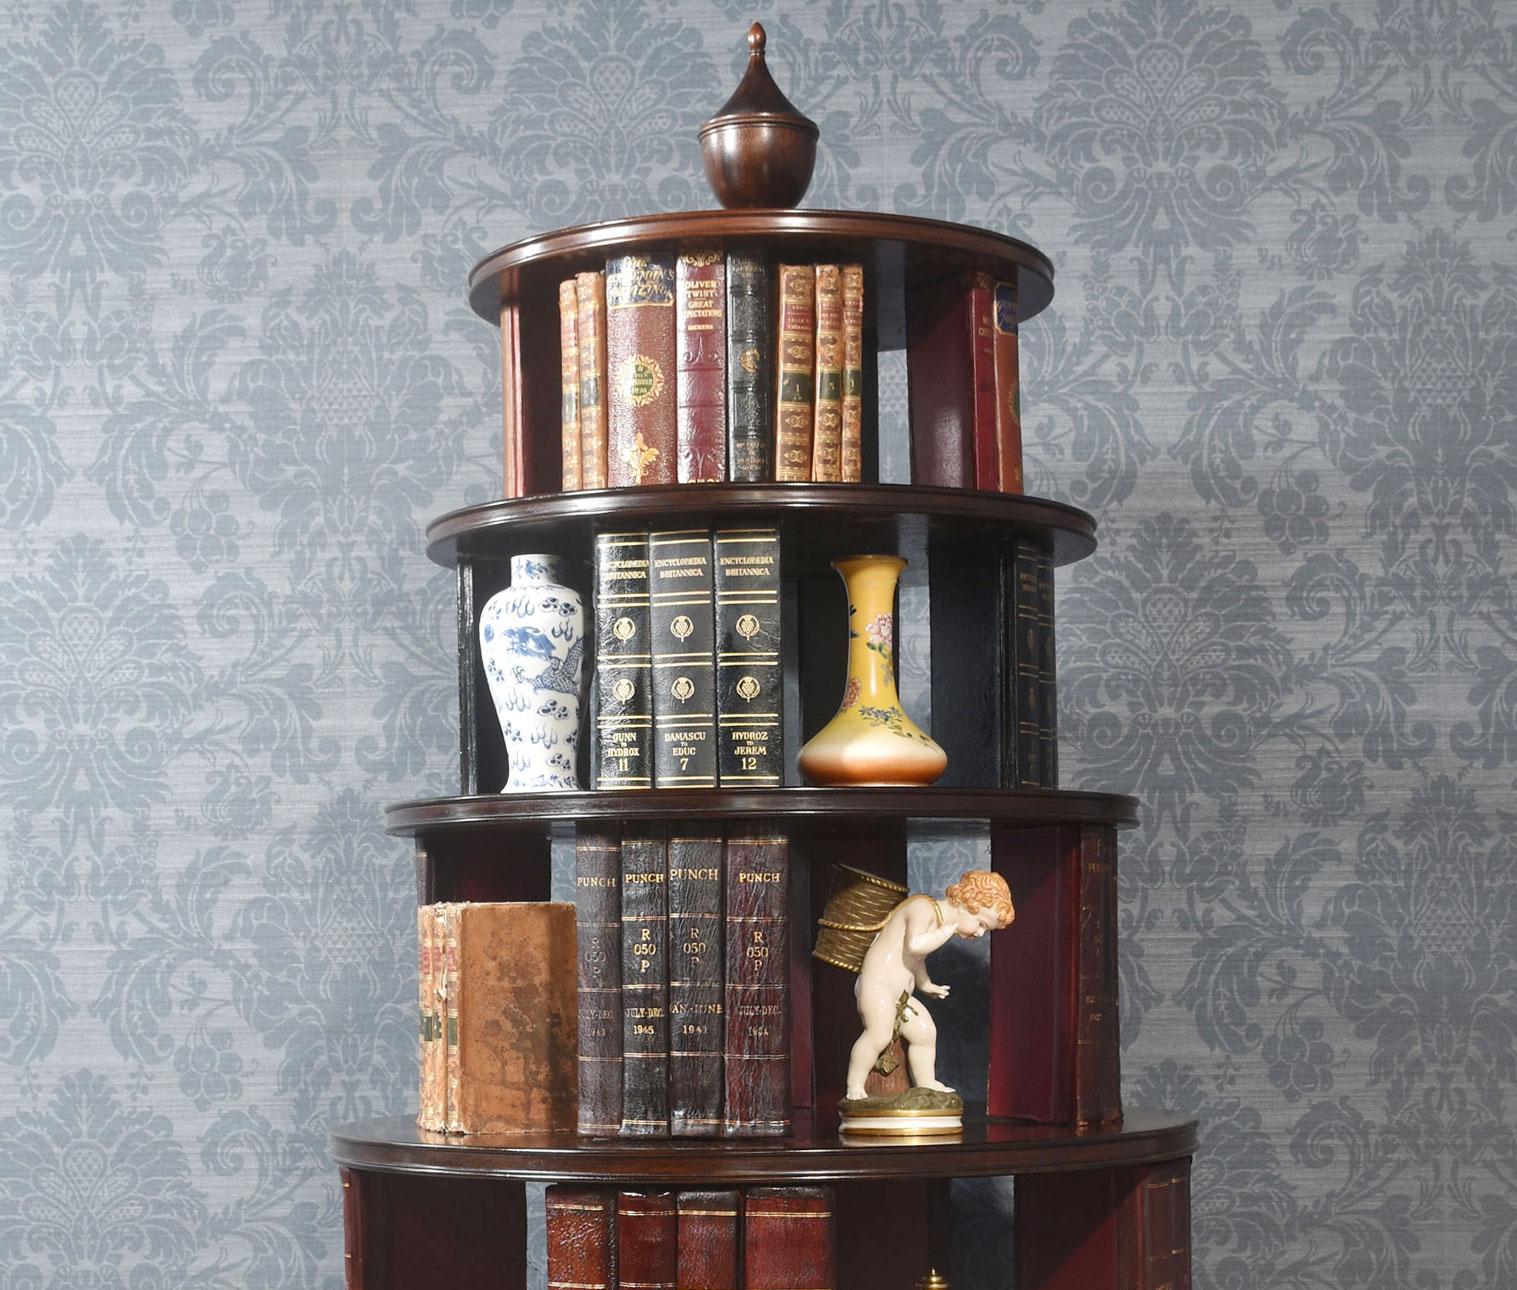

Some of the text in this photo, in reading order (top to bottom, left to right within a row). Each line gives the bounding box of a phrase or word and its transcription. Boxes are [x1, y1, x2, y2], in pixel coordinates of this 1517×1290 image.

[685, 280, 718, 289] OLIVER
[686, 290, 714, 299] TWIST
[688, 300, 714, 309] GREAT
[659, 568, 704, 579] BRITANNICA
[725, 568, 771, 577] BRITANNICA
[612, 732, 637, 742] GUNN
[664, 732, 706, 742] DAMASCU
[732, 731, 769, 741] HYDROZ
[607, 747, 640, 757] HYDROX
[672, 747, 697, 756] EDUC
[734, 746, 767, 755] JEREM
[618, 758, 629, 772] 11
[680, 758, 689, 771] 7
[741, 757, 757, 770] 12
[625, 873, 665, 884] PUNCH
[669, 868, 719, 881] PUNCH
[739, 872, 781, 883] PUNCH
[577, 876, 616, 888] PUNCH
[641, 928, 651, 941] R
[690, 928, 700, 938] R
[754, 931, 764, 943] R
[633, 943, 656, 955] 050
[683, 942, 706, 954] 050
[746, 946, 769, 958] 050
[640, 960, 650, 973] P
[690, 956, 700, 967] P
[754, 960, 763, 971] P
